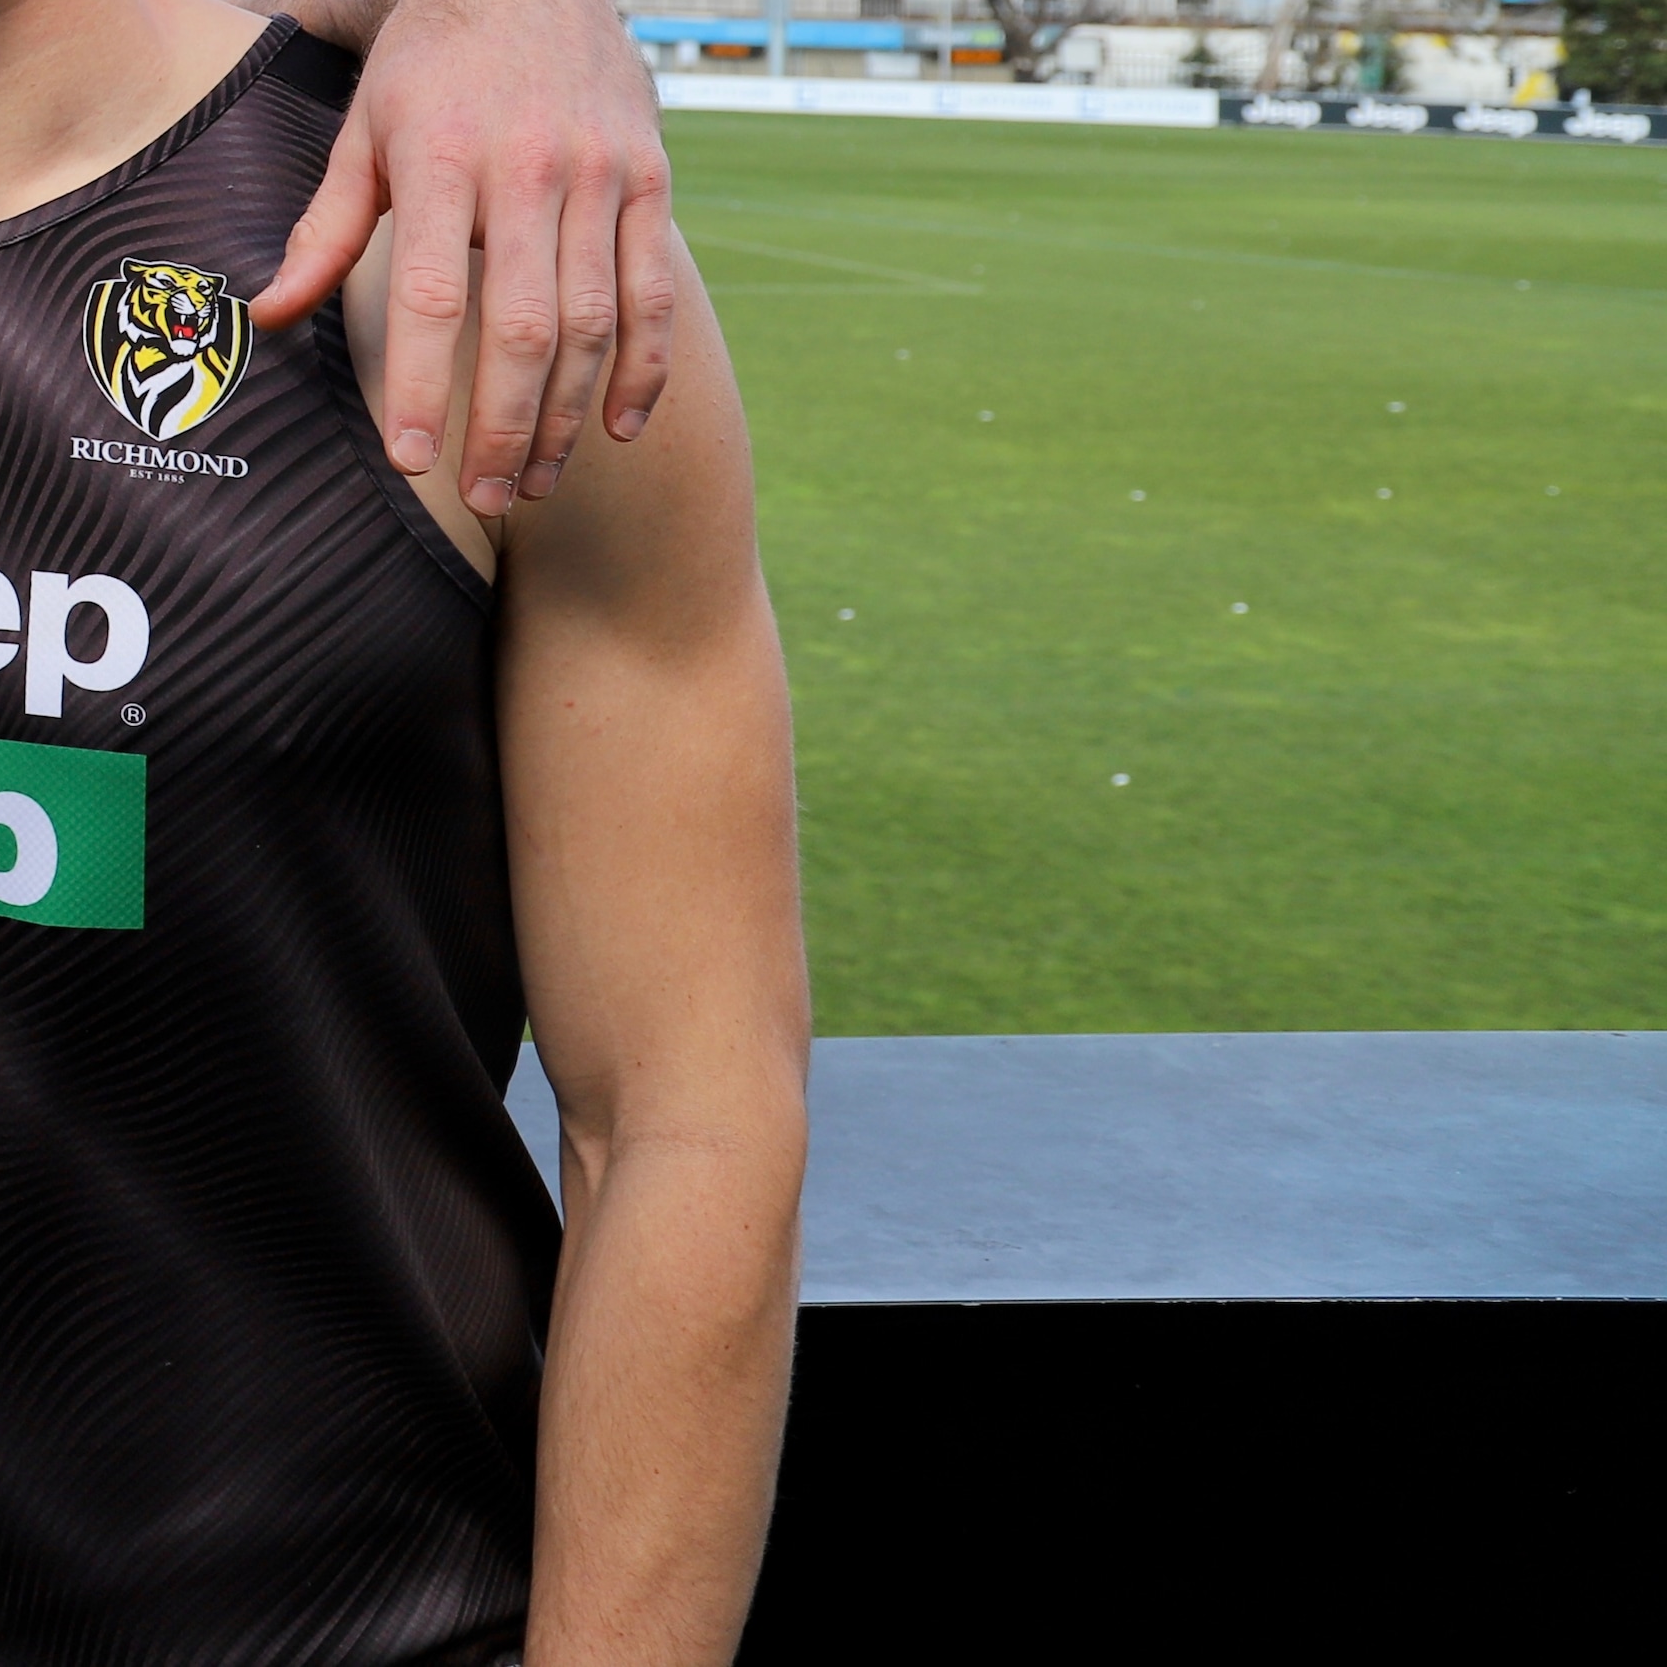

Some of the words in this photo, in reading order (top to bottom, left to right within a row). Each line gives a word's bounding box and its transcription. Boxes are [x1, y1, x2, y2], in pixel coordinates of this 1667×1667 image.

[1241, 92, 1322, 129] Jeep
[1346, 95, 1428, 133] Jeep
[1453, 99, 1538, 139] Jeep
[1563, 104, 1651, 143] Jeep
[69, 436, 250, 479] RICHMOND
[128, 468, 154, 480] EST
[157, 473, 186, 485] 1885
